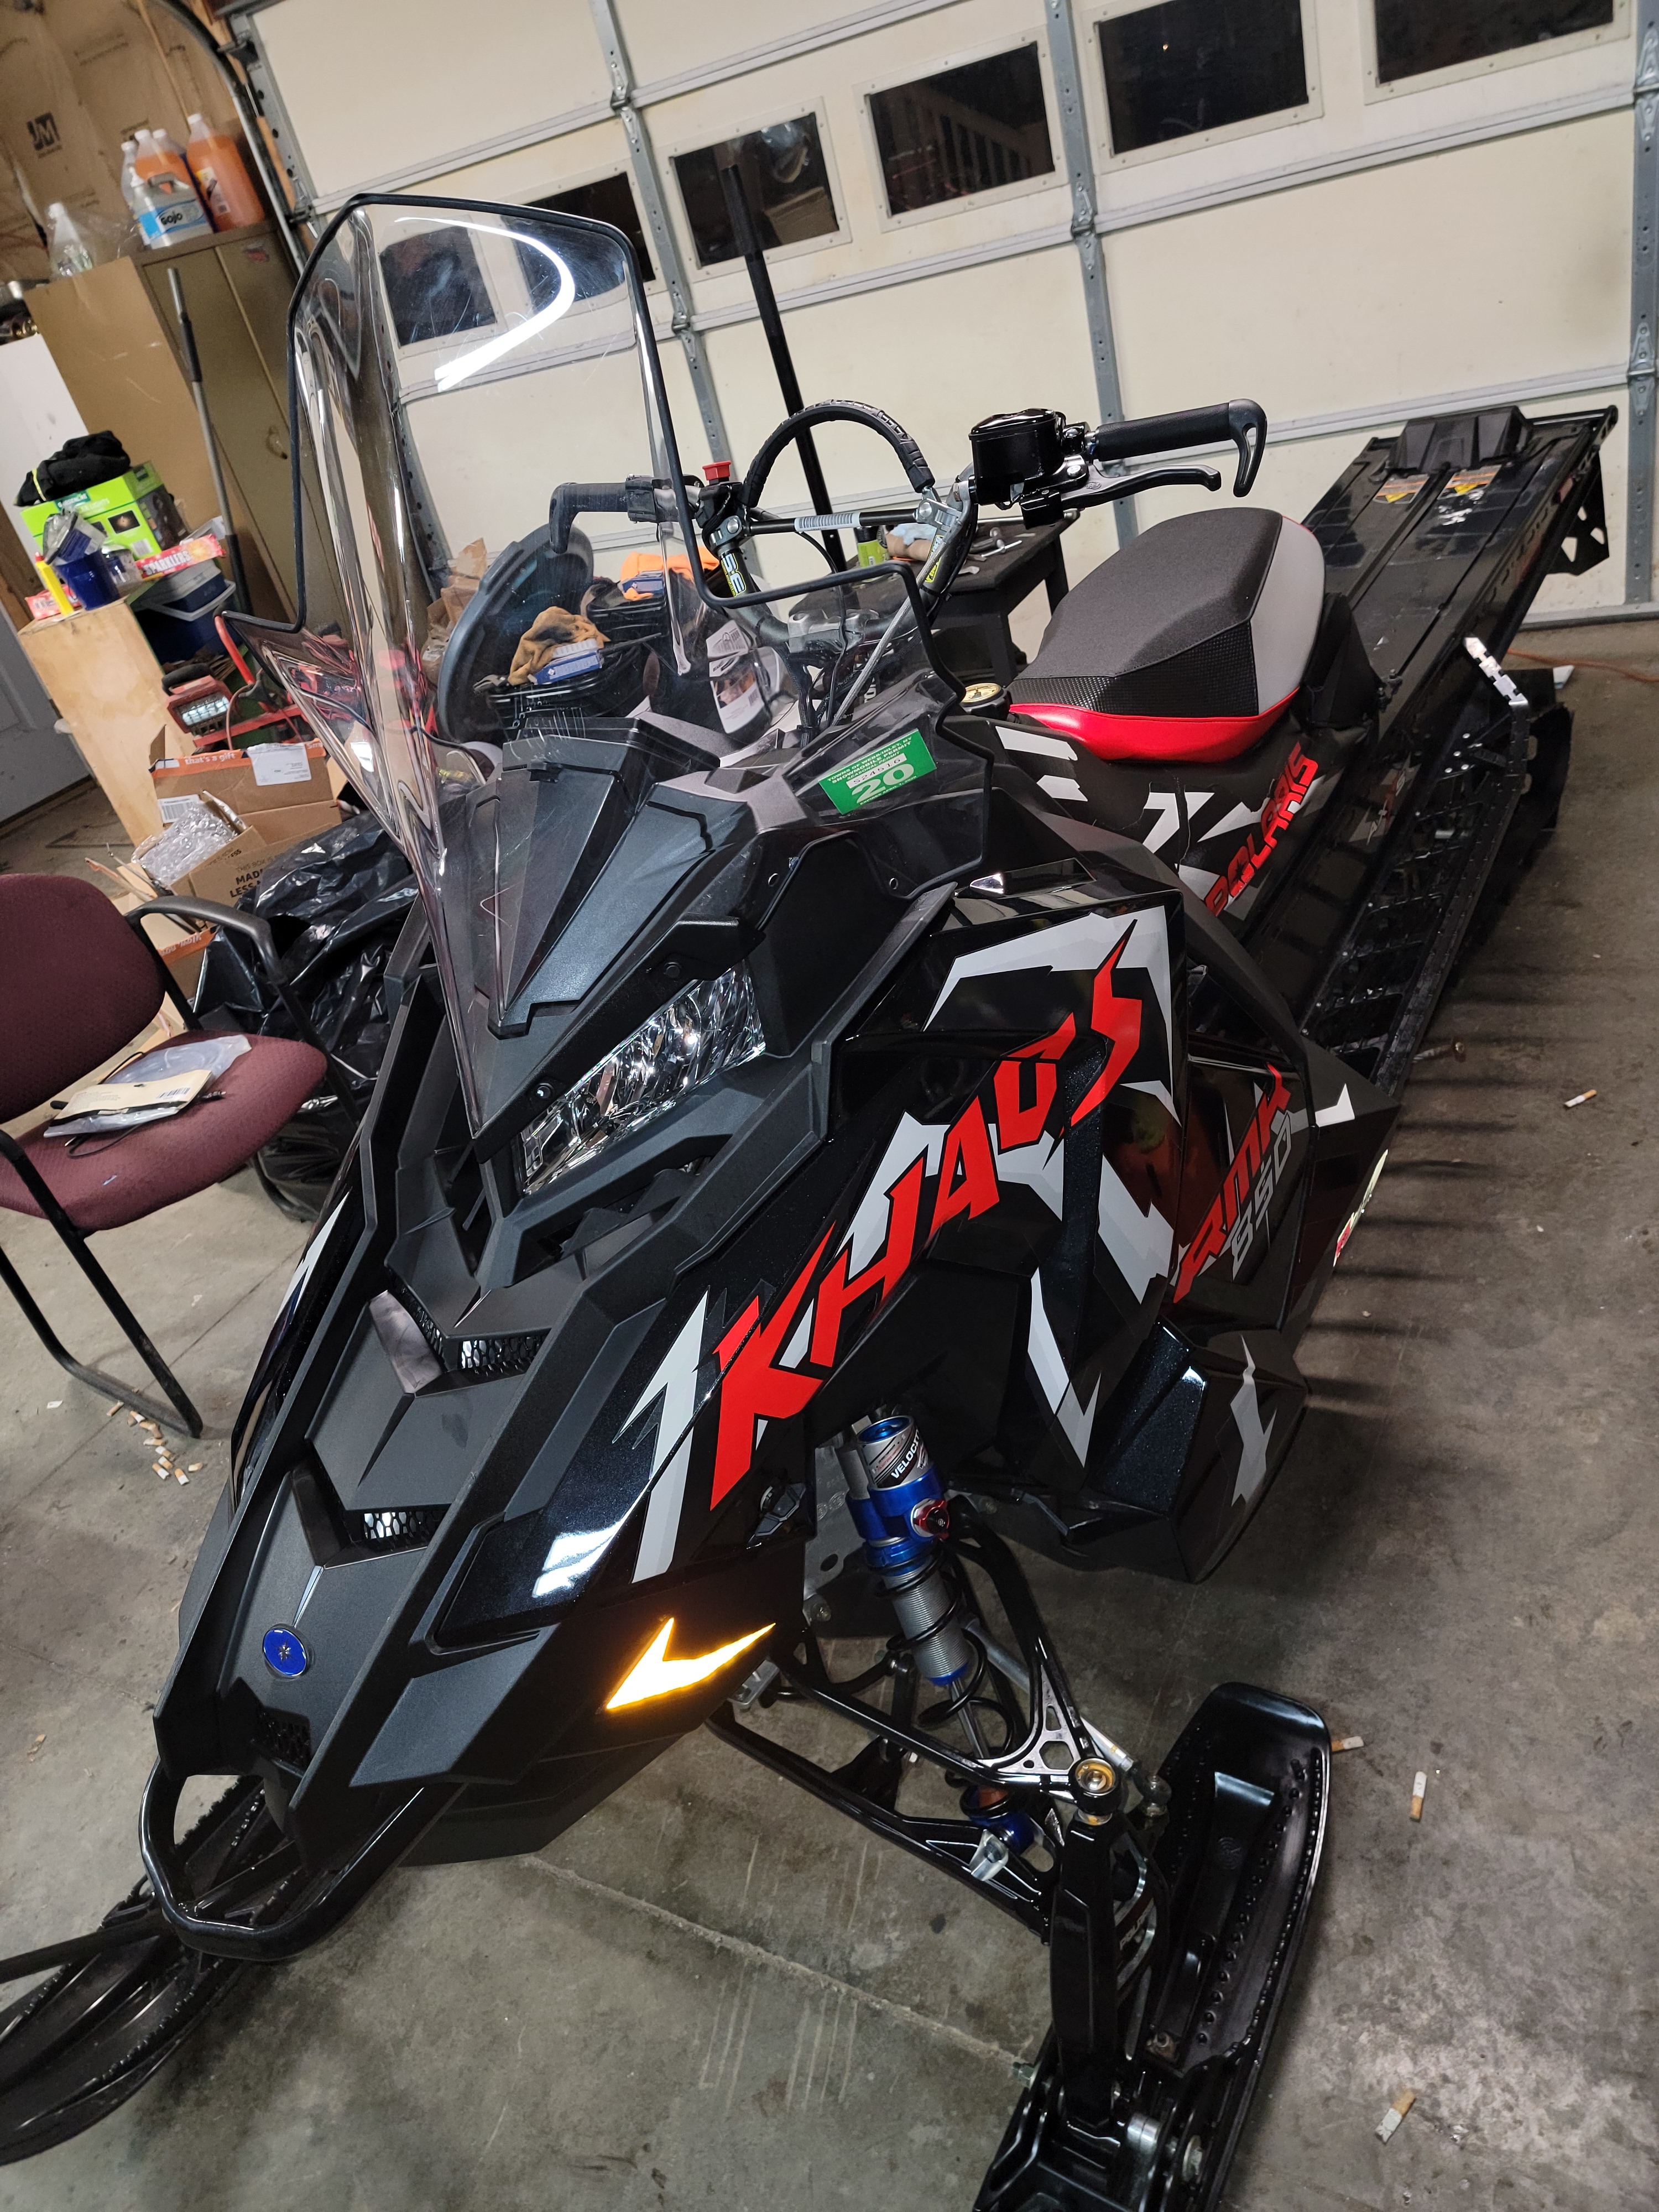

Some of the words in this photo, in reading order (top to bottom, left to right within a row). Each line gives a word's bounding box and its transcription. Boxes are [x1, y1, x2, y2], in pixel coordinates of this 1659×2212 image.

[143, 550, 192, 576] SPARKLERS
[184, 755, 211, 765] that's
[219, 752, 236, 764] gift
[827, 768, 851, 781] TOWNS
[832, 756, 882, 784] SNOWMOBILE
[883, 740, 911, 758] PERMIT
[847, 762, 877, 780] SEASONAL
[878, 751, 900, 765] PERMIT
[853, 758, 901, 784] S24516
[852, 764, 914, 804] 20
[860, 792, 882, 805] EXPIRES
[883, 785, 897, 793] APRIL
[1204, 742, 1318, 916] POLARIS
[1173, 1062, 1291, 1303] RMK
[1232, 1113, 1292, 1280] 850
[711, 930, 1142, 1511] KHAOS
[891, 1429, 920, 1479] VELOCIT
